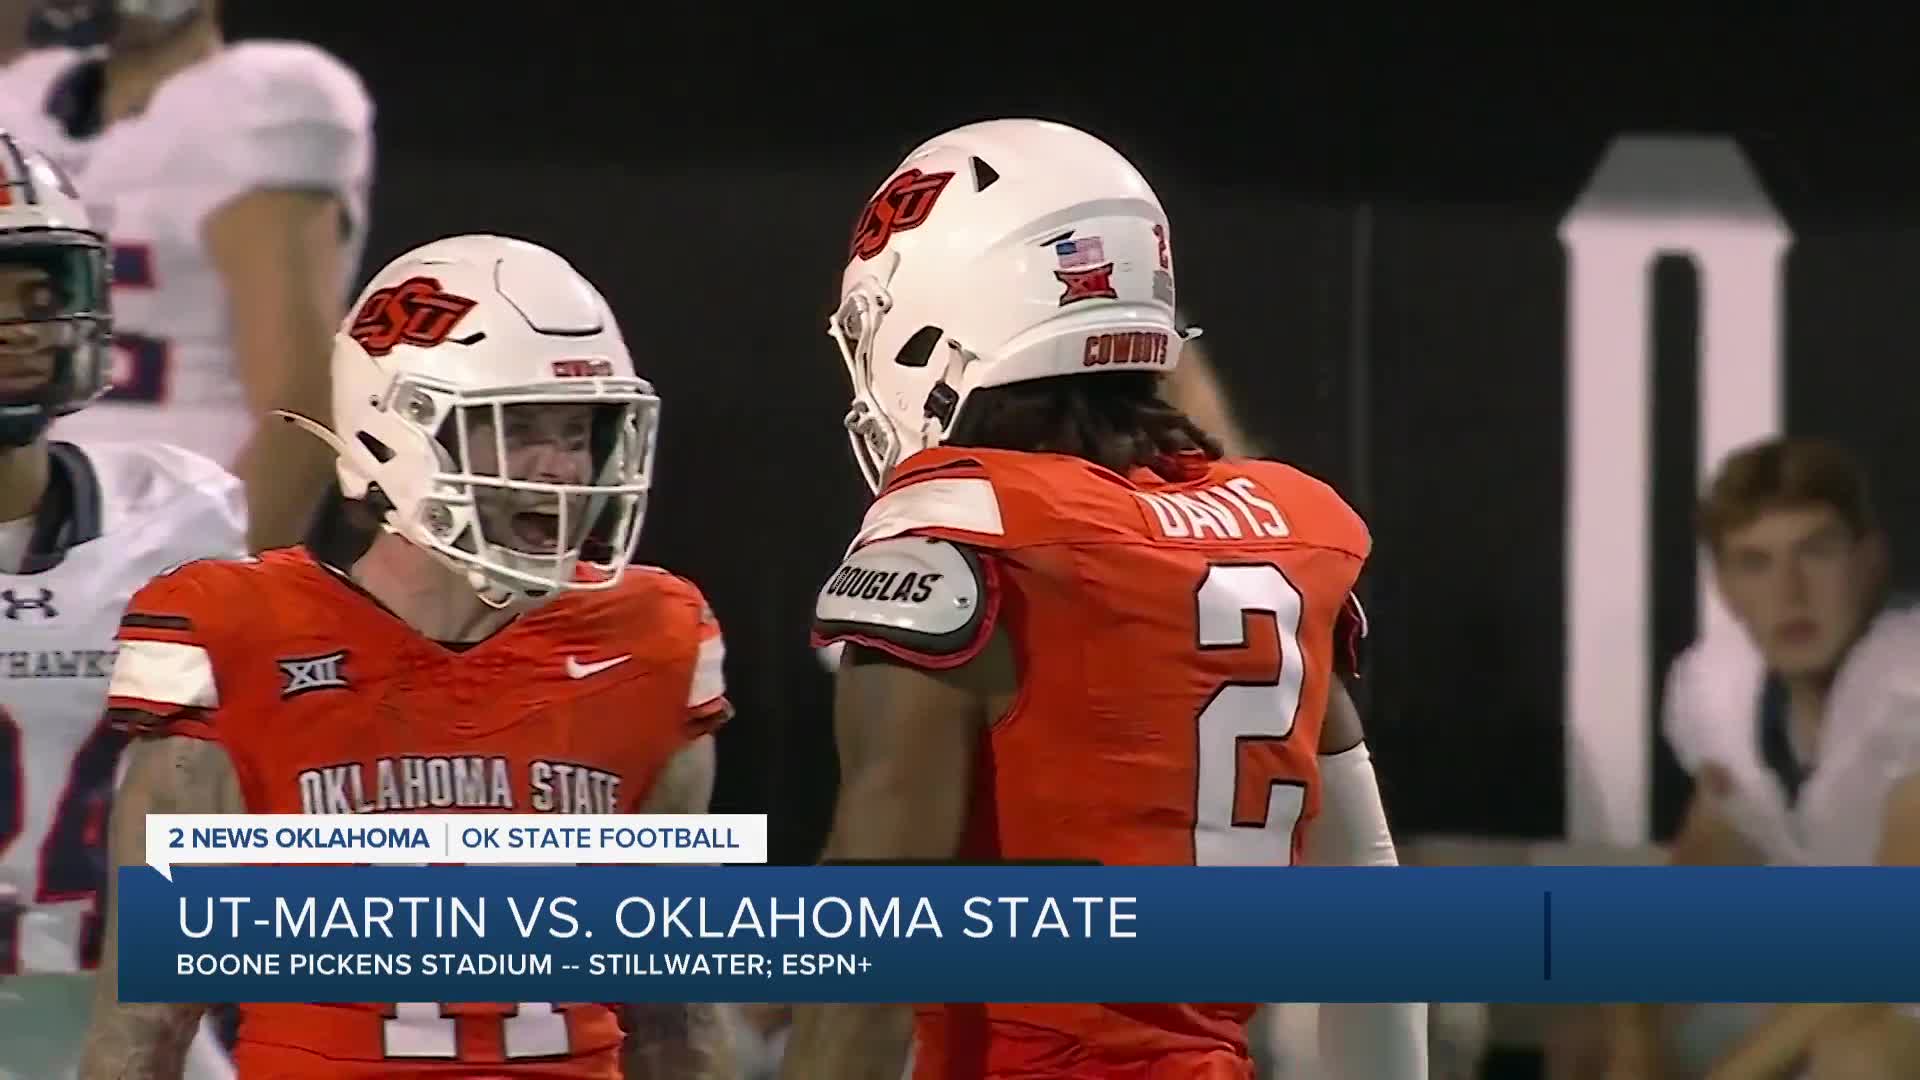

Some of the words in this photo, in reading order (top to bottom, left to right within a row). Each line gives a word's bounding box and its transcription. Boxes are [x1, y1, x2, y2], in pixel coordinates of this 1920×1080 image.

[351, 276, 478, 357] OSU
[1083, 331, 1168, 367] COWBOYS
[1134, 477, 1290, 539] DAVIS
[827, 565, 944, 603] DOUGLAS
[0, 651, 117, 678] HAWK
[1194, 563, 1306, 866] 2
[299, 754, 513, 814] OKLAHOMA
[527, 758, 624, 814] STATE
